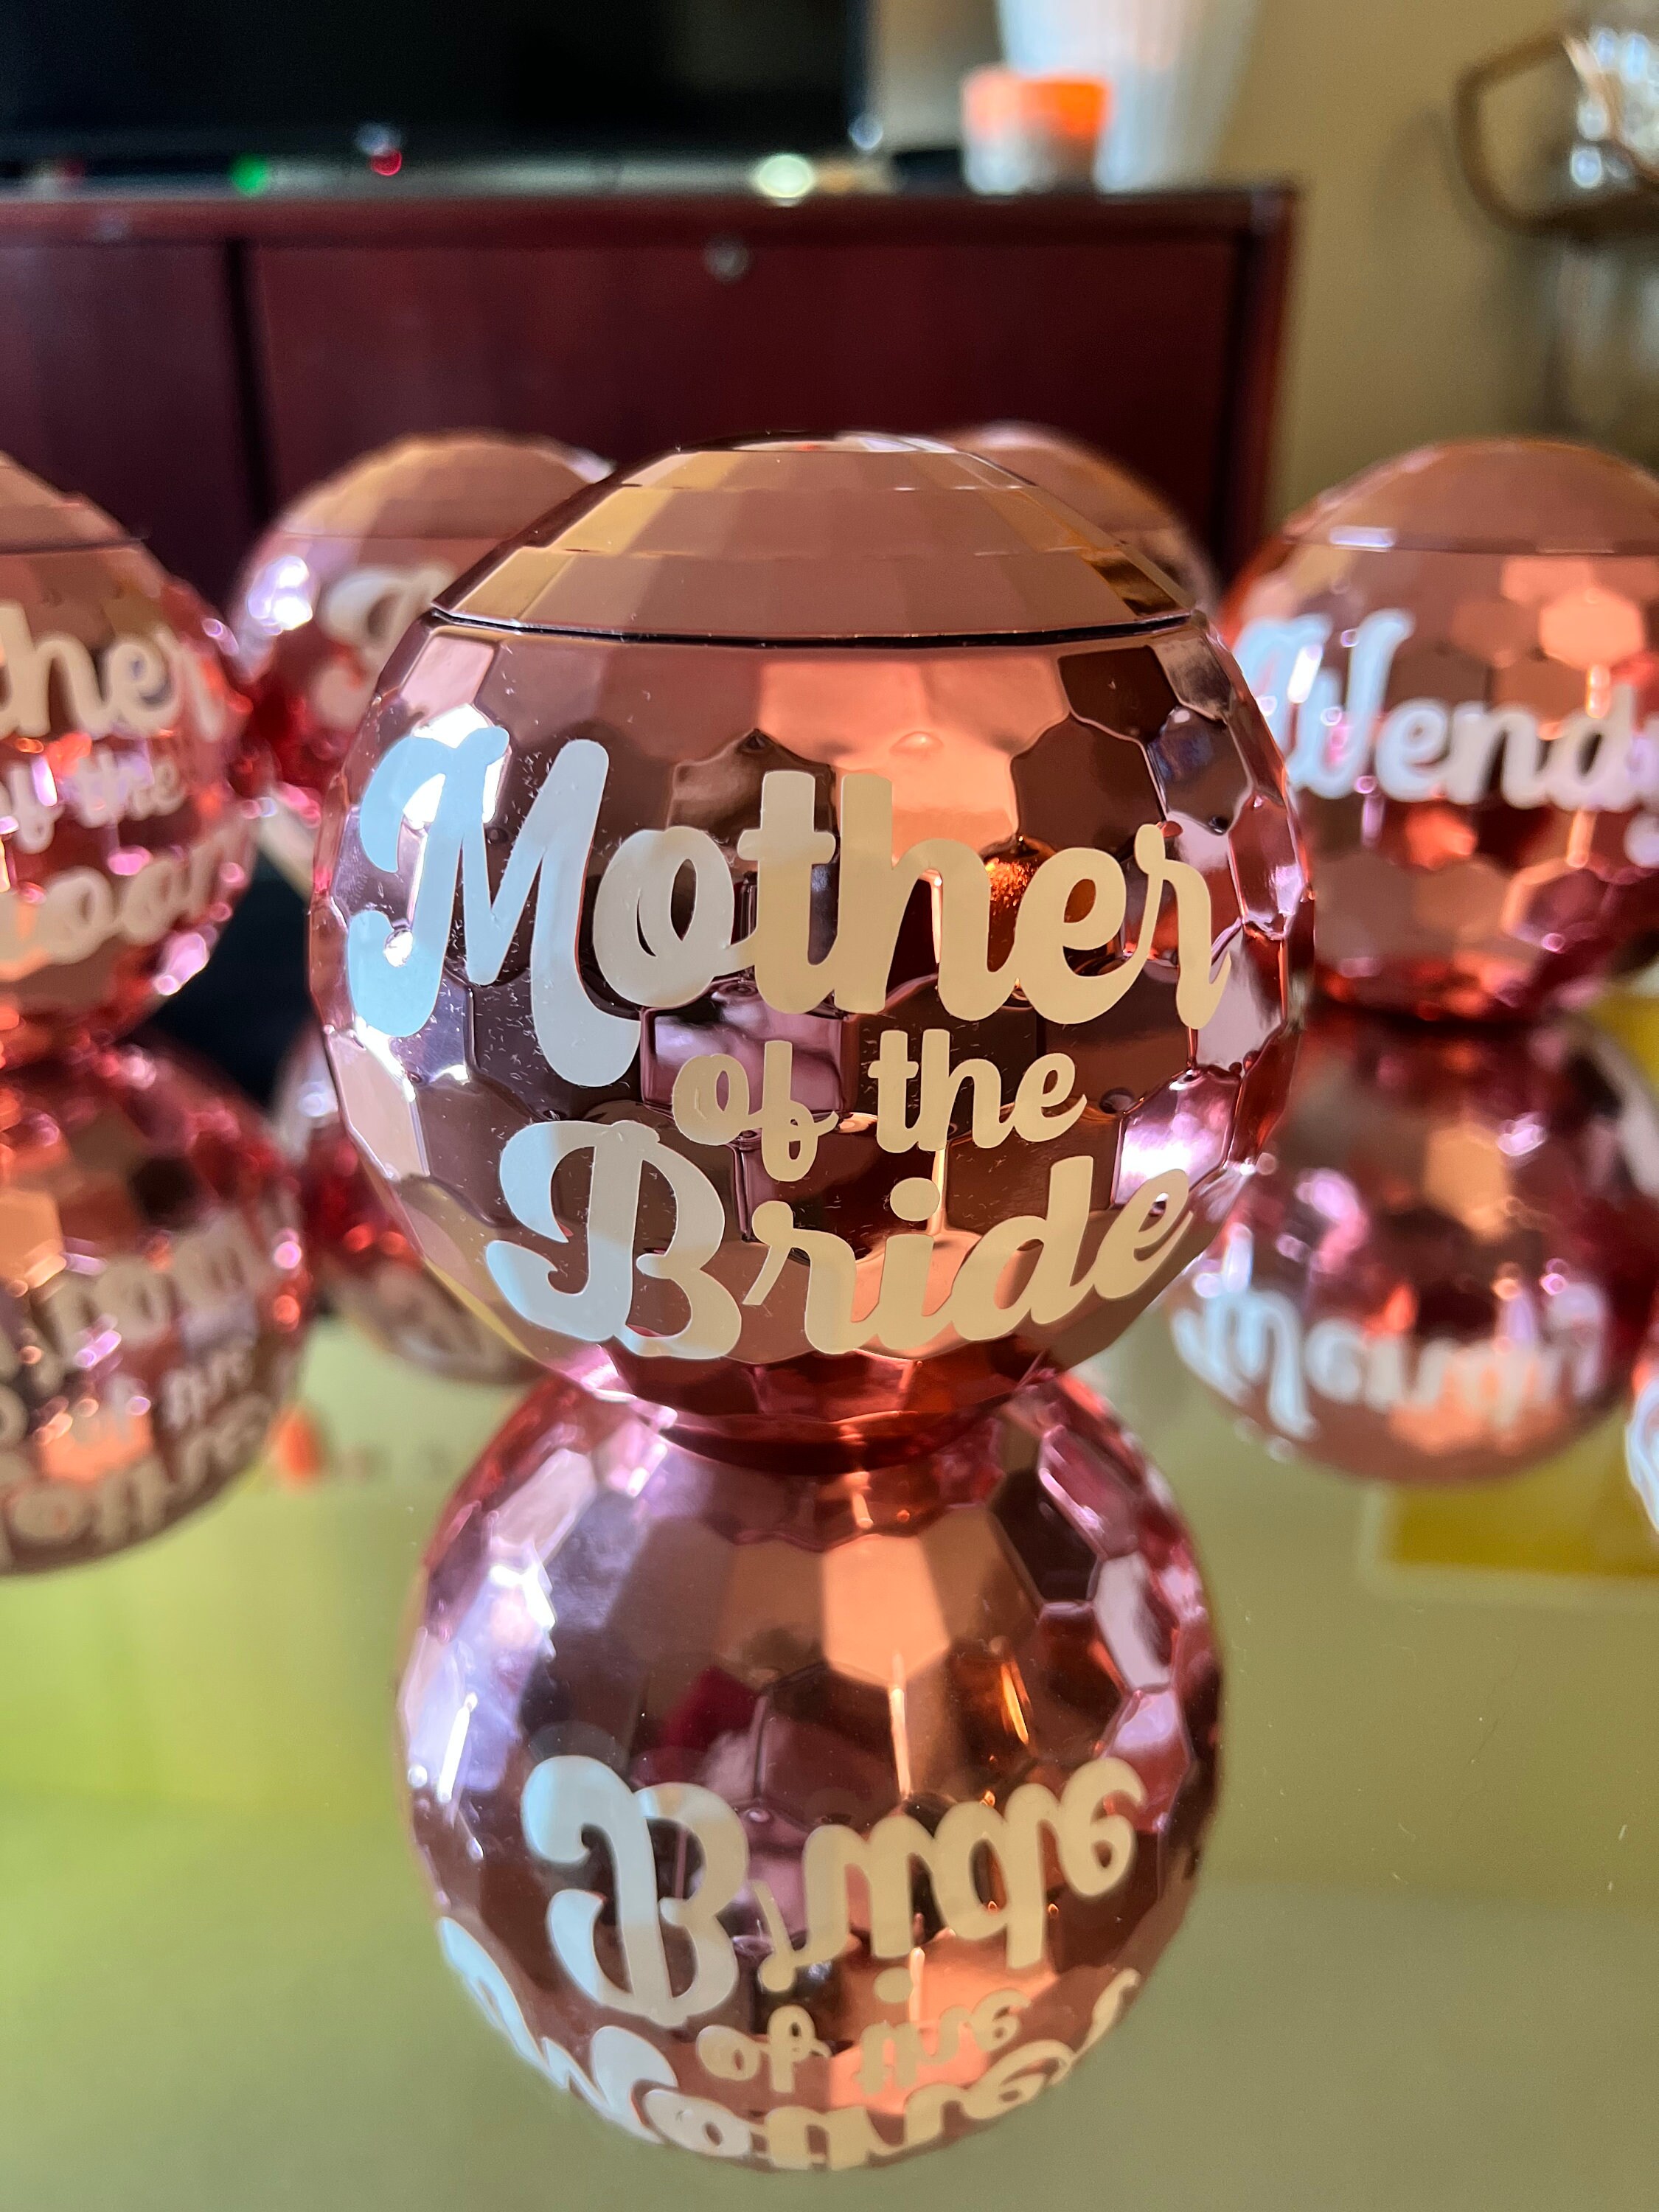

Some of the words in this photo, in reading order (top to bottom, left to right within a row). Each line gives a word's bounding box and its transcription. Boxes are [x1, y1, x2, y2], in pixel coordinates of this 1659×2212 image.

[0, 599, 223, 741] her
[346, 726, 1232, 1088] Mother
[672, 1039, 840, 1182] of
[868, 1028, 1087, 1154] the
[485, 1119, 1195, 1361] Bride
